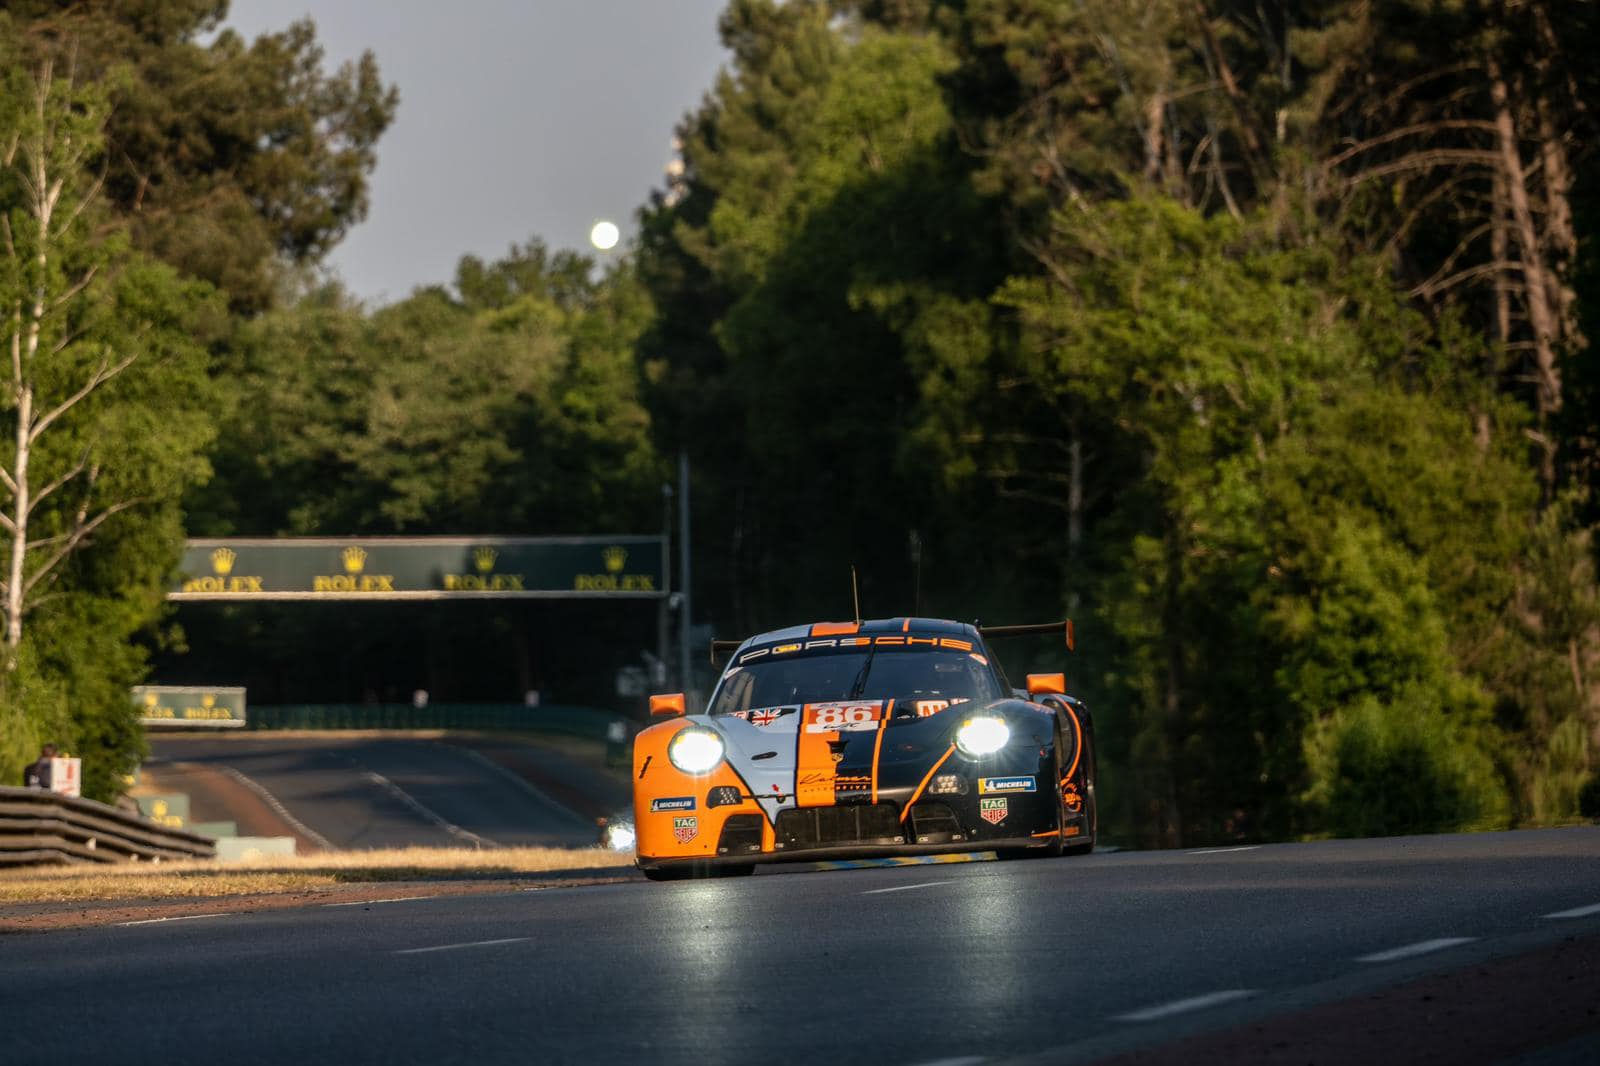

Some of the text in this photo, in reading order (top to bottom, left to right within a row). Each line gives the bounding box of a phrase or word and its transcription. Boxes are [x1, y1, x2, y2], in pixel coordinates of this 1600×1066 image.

[313, 575, 394, 592] ROLEX
[443, 574, 525, 591] ROLEX
[574, 574, 655, 591] ROLEX
[740, 637, 972, 664] PORSCHE
[816, 706, 873, 724] 86
[996, 781, 1032, 789] MICHELIN
[982, 800, 1006, 808] TAG
[675, 819, 696, 827] TAG
[981, 809, 1008, 823] HEUER
[675, 828, 697, 841] HEUER
